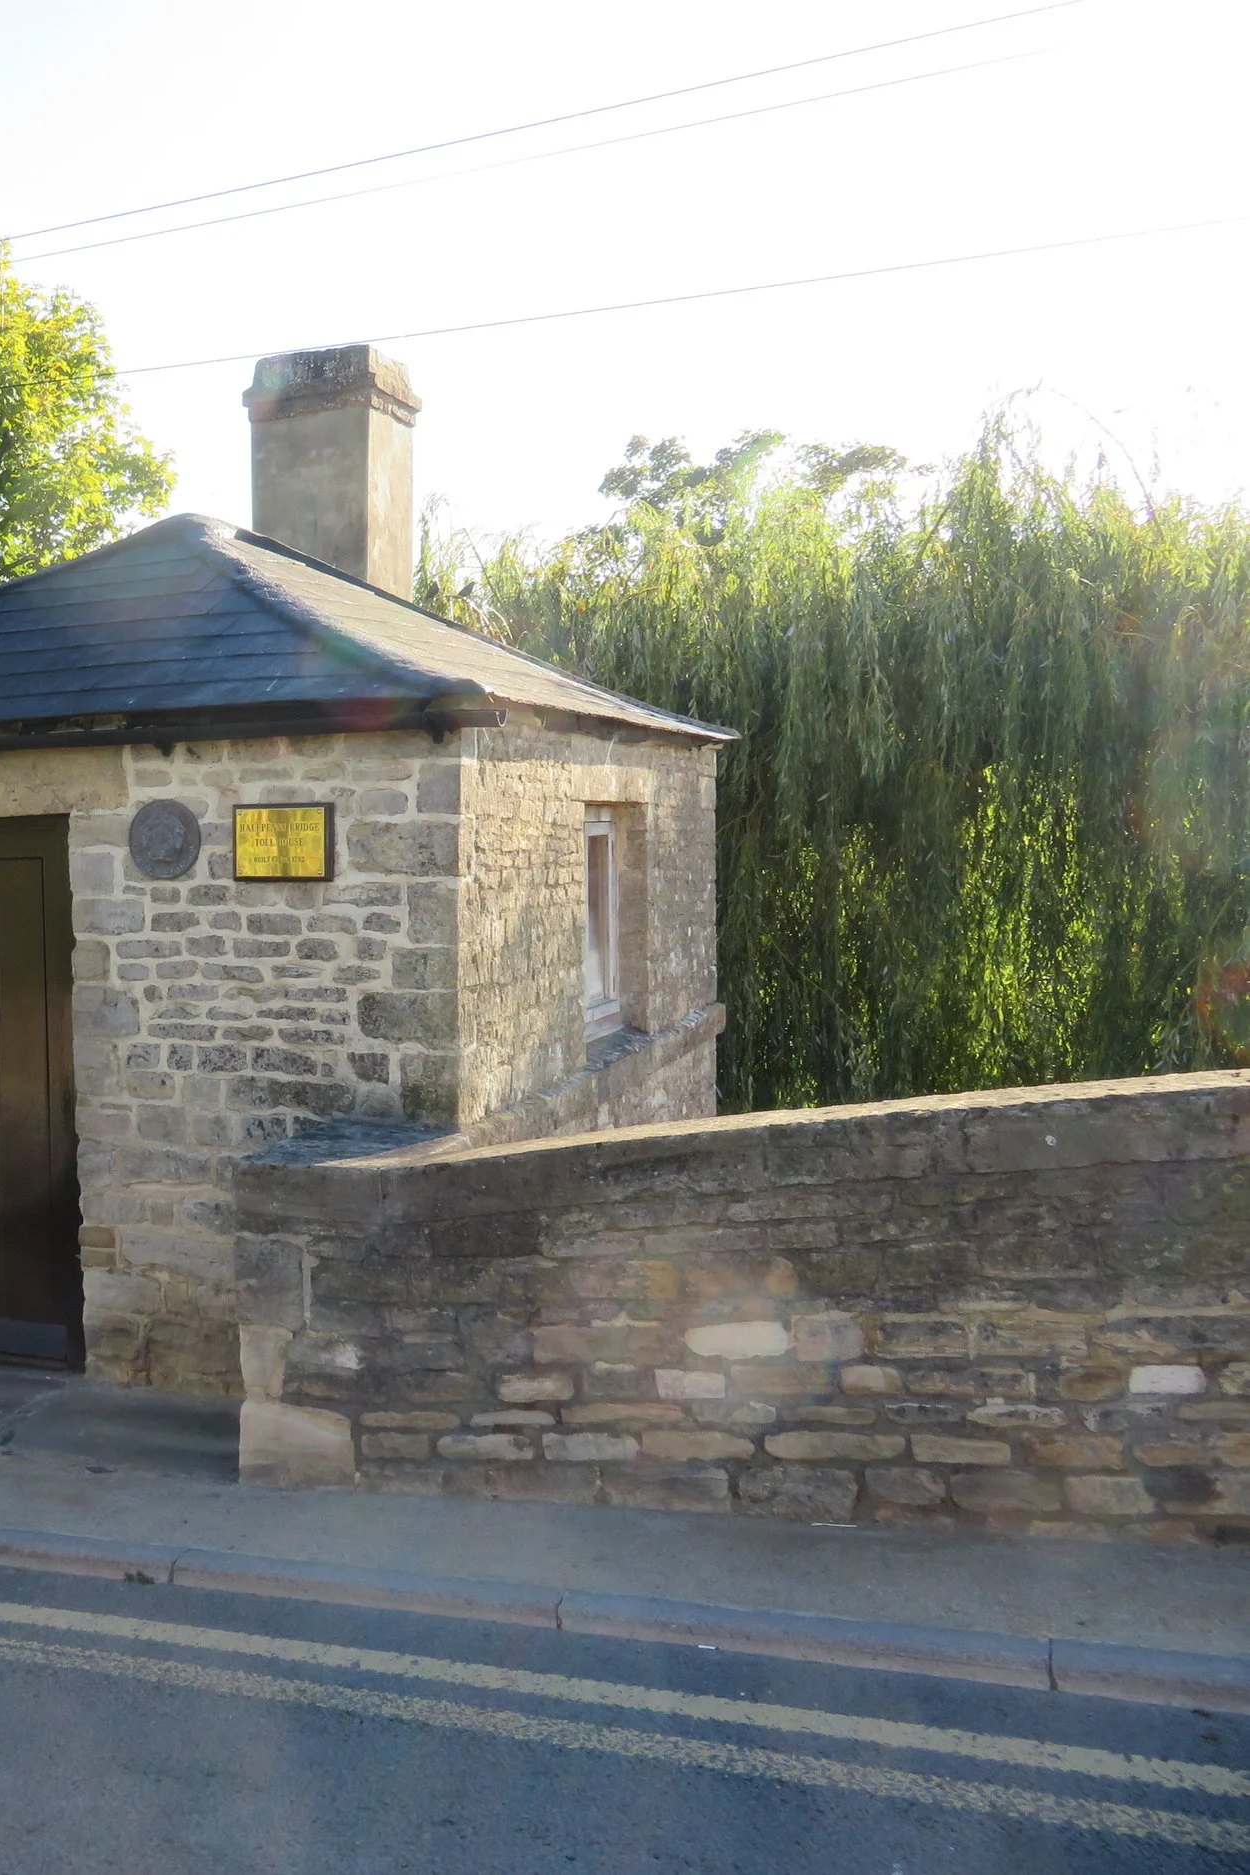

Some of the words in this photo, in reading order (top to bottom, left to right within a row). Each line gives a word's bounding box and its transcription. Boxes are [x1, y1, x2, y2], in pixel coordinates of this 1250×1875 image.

[289, 822, 320, 832] BRIDGE
[255, 838, 275, 847] TOLL
[278, 837, 305, 847] HOUSE
